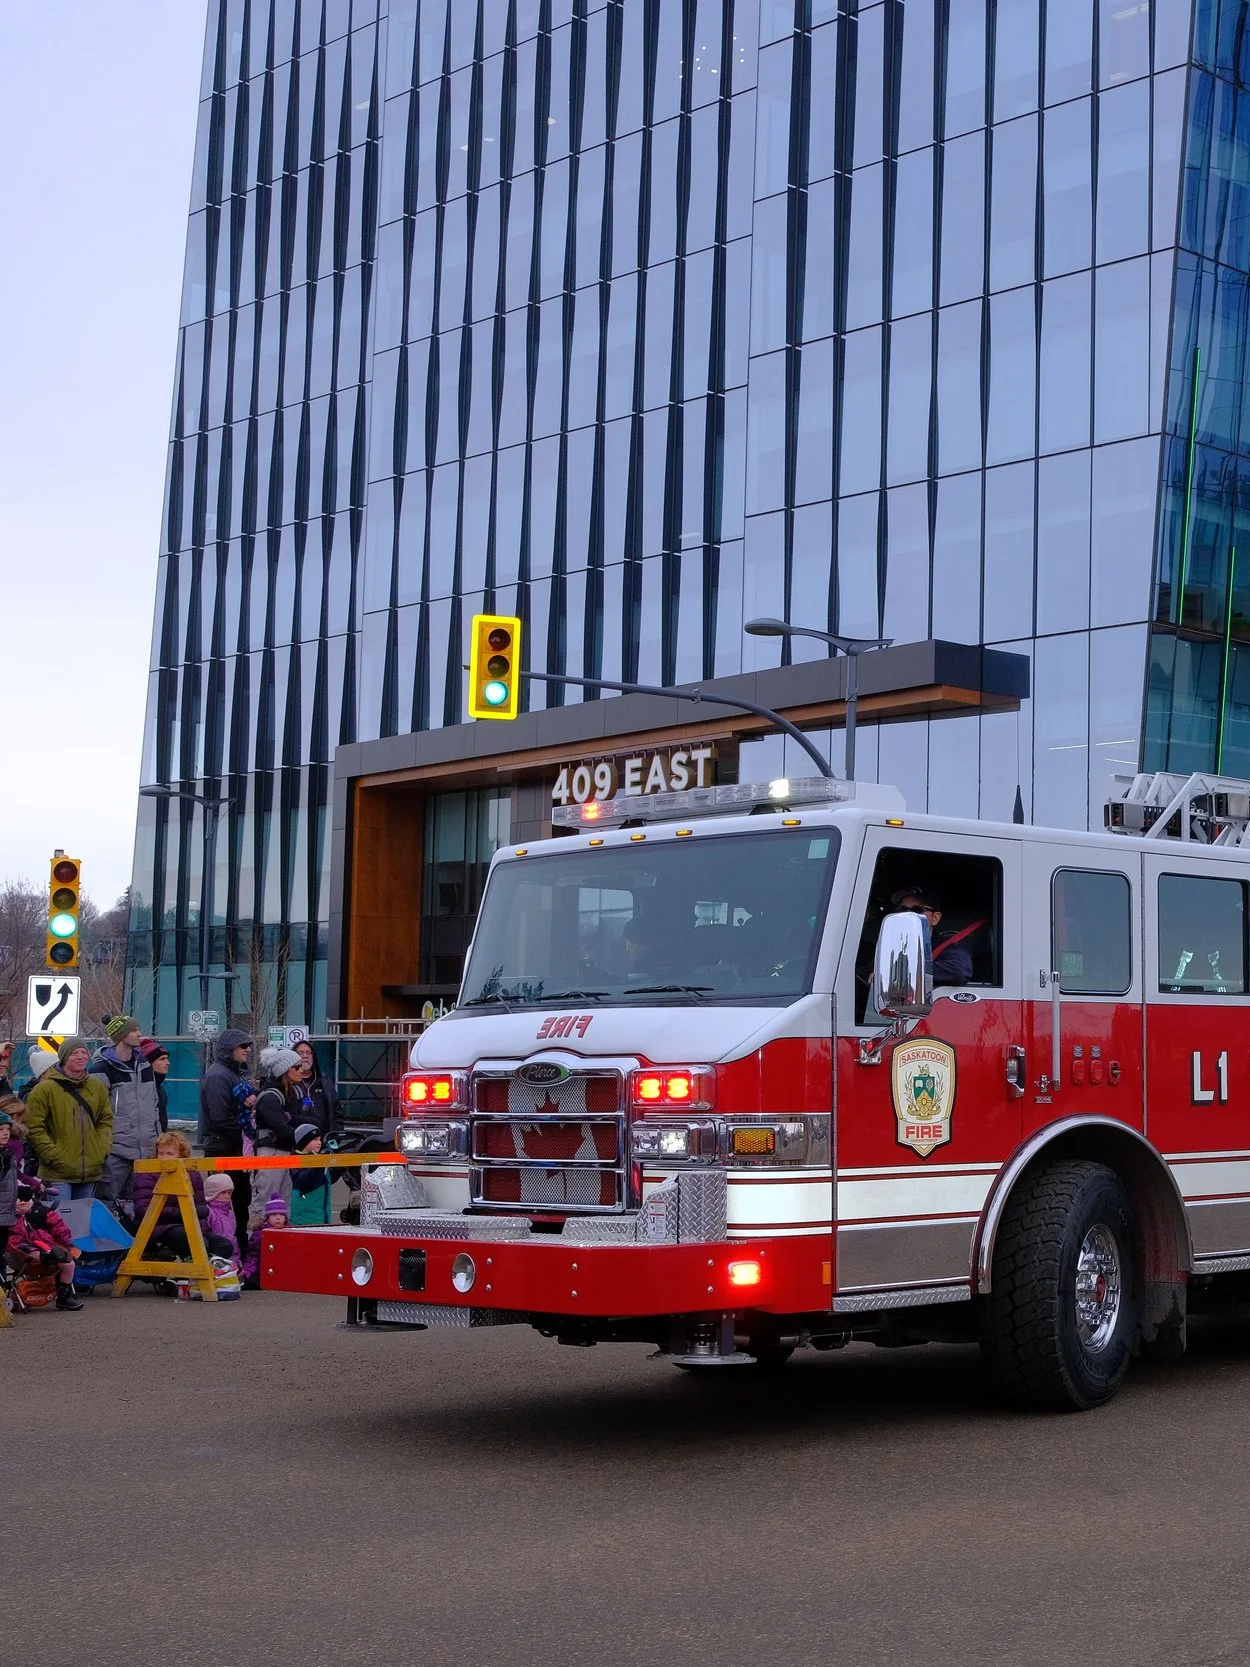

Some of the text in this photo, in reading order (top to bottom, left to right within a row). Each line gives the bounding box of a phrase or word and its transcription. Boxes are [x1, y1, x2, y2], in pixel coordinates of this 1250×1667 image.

[551, 747, 712, 805] 409 EAST
[901, 1050, 947, 1064] SASKATOON
[525, 1064, 557, 1080] Pierce
[1191, 1050, 1228, 1104] L1
[905, 1124, 943, 1139] FIRE
